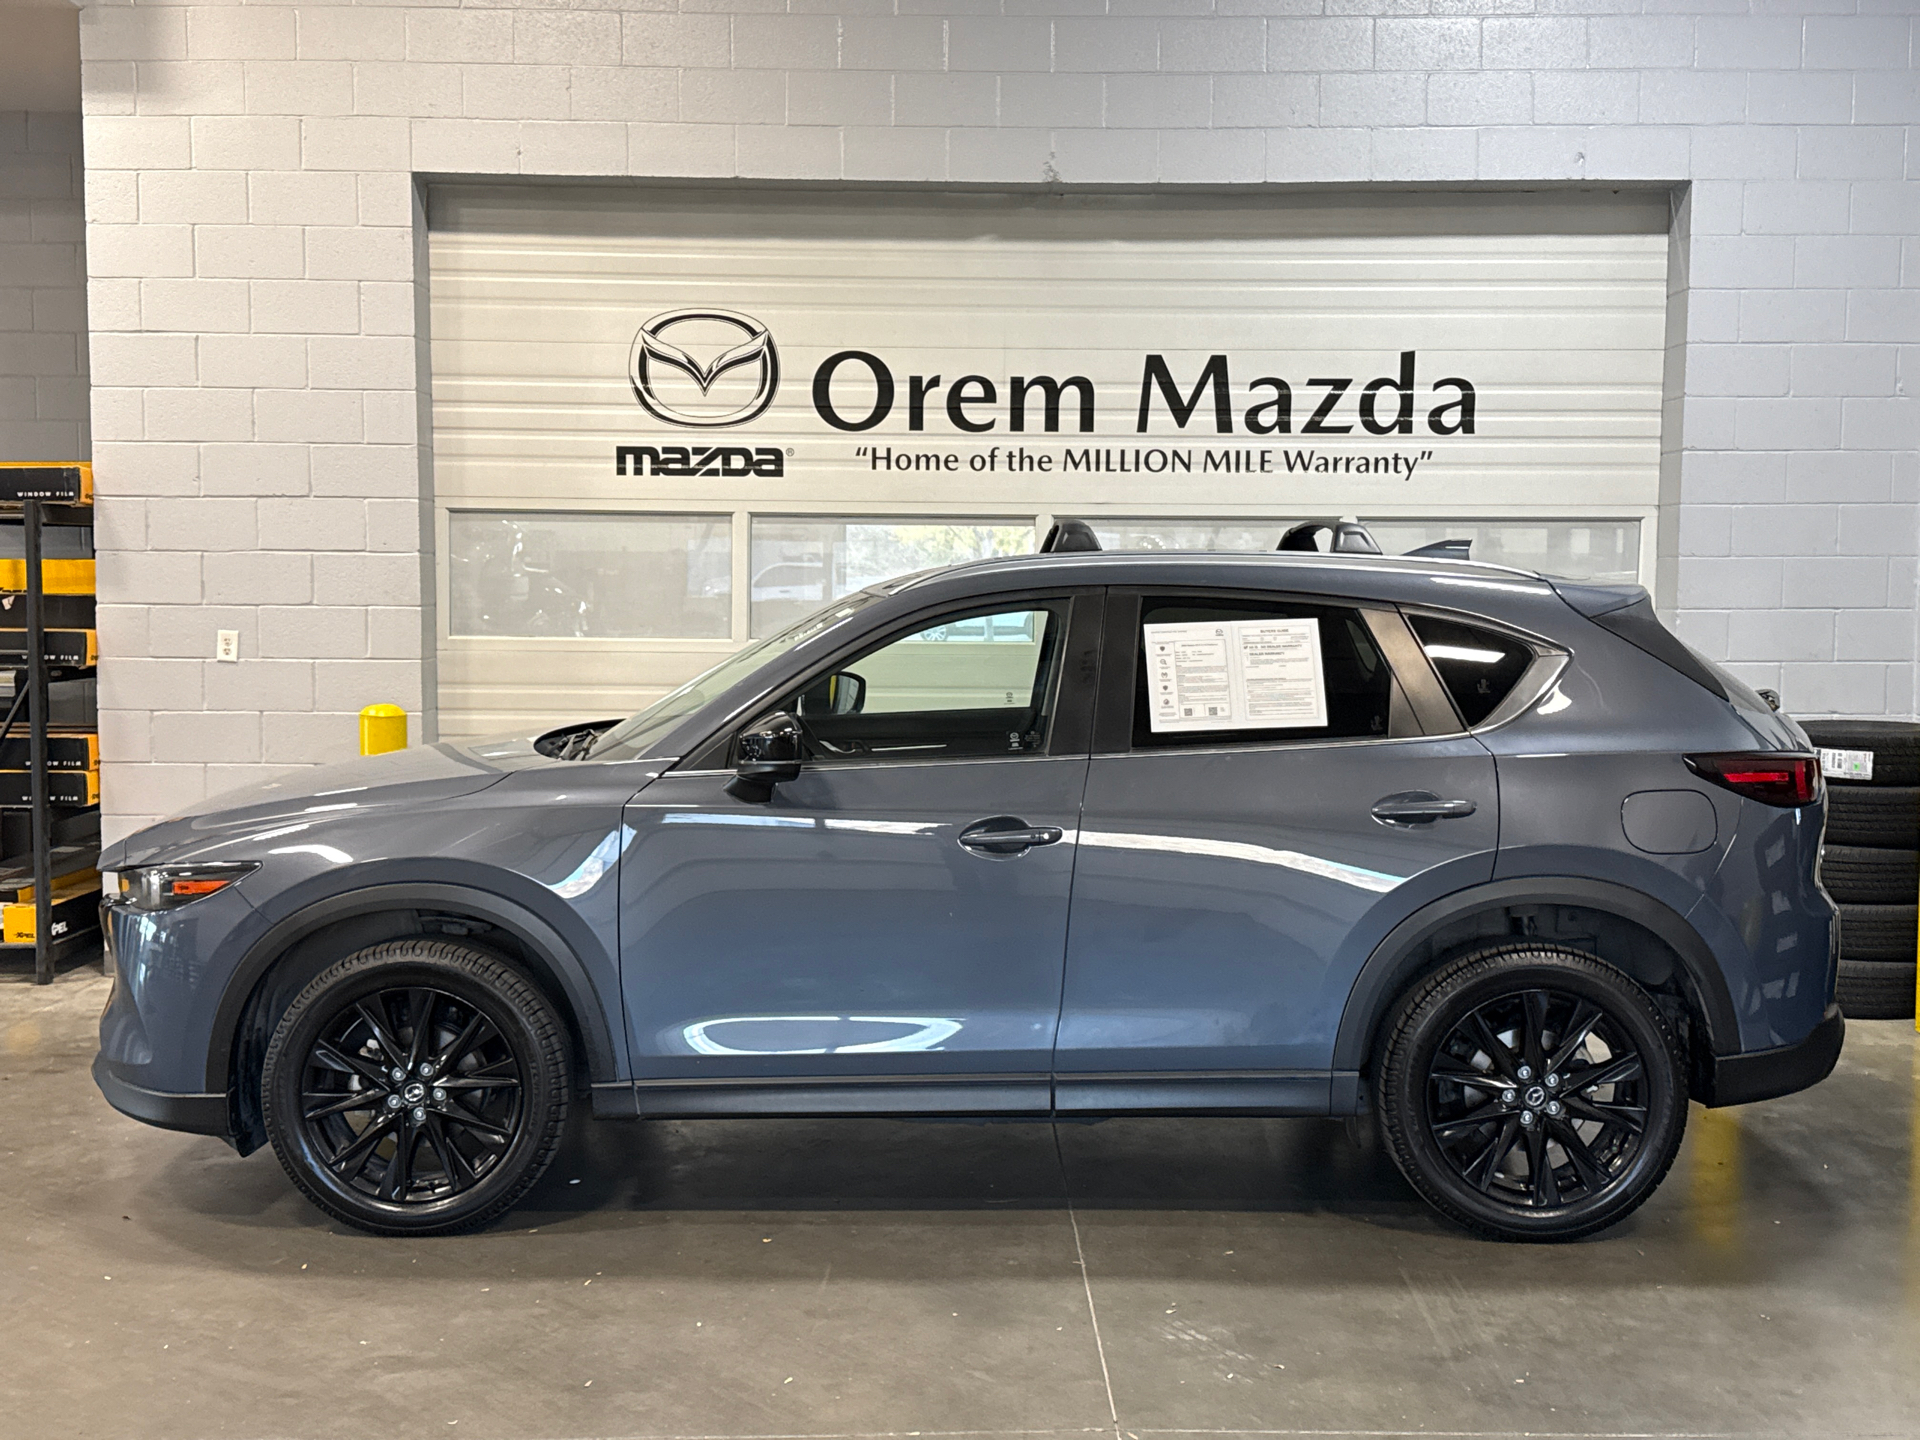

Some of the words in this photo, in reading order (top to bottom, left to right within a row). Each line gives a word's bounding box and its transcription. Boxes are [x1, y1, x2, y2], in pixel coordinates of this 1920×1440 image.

[813, 351, 1095, 432] Orem
[1137, 351, 1476, 435] Mazda
[969, 447, 1000, 472] of
[1007, 448, 1053, 472] the
[1063, 449, 1192, 473] MILLION
[1203, 450, 1273, 473] MILE
